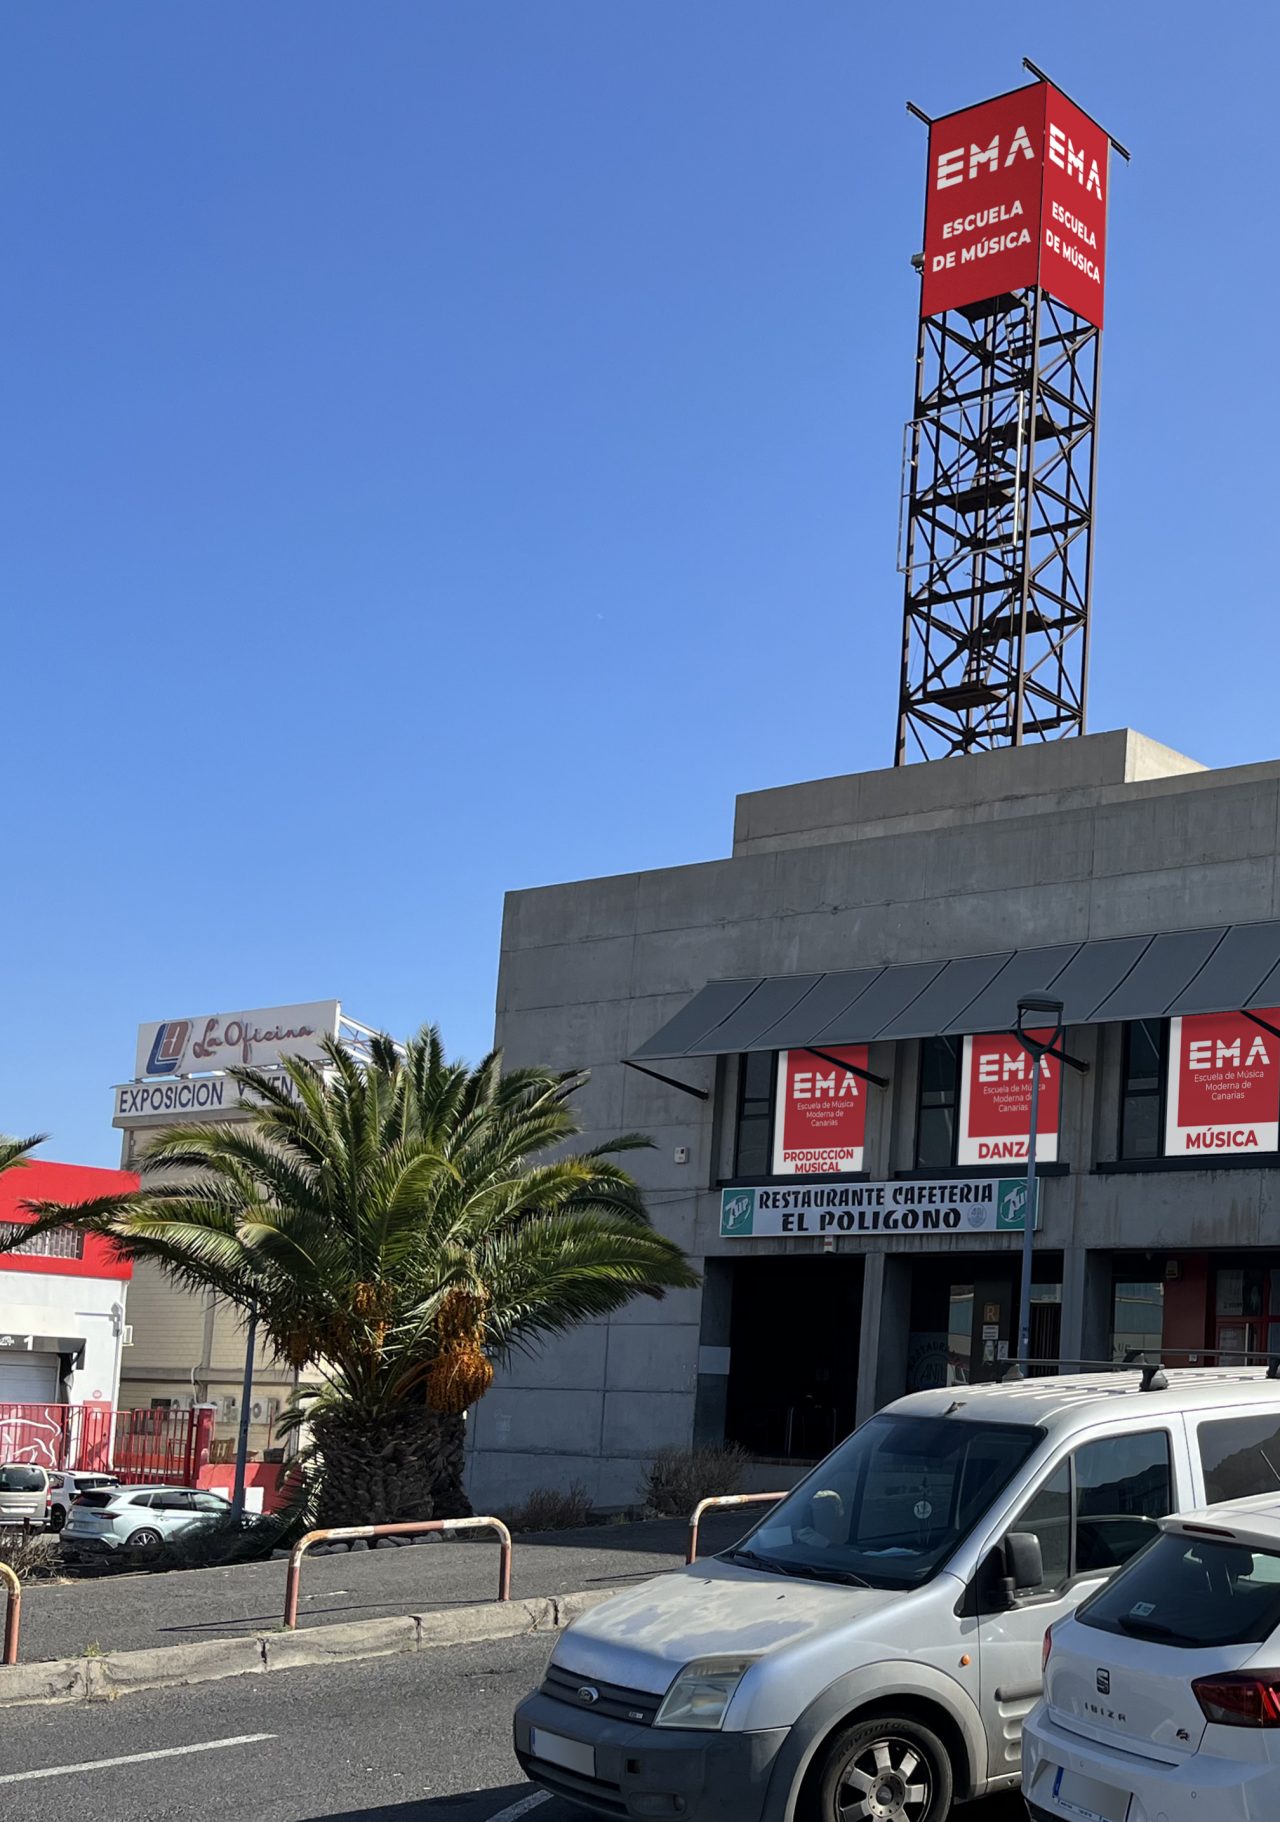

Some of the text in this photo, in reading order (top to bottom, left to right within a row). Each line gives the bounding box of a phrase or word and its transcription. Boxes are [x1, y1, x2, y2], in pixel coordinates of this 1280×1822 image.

[936, 125, 1035, 190] EMA
[1049, 122, 1103, 201] EMA
[942, 200, 1024, 240] ESCUELA
[1052, 200, 1097, 249] ESCUELA
[932, 228, 1032, 273] DE MÚSICA
[1045, 228, 1101, 284] DE MÚSICA
[193, 1018, 314, 1064] La Oficina
[1189, 1036, 1270, 1070] EMA
[793, 1071, 859, 1099] EMA
[1194, 1070, 1264, 1083] Escuela de Música
[1205, 1080, 1252, 1091] Moderna de
[119, 1081, 224, 1113] EXPOSICION
[983, 1084, 1009, 1094] Escuela
[1010, 1083, 1020, 1092] de
[993, 1094, 1024, 1103] Moderna
[1211, 1091, 1245, 1101] Canarias
[797, 1101, 821, 1110] Escuela
[832, 1099, 854, 1108] Música
[806, 1109, 844, 1118] Moderna de
[998, 1104, 1028, 1113] Canarias
[811, 1119, 838, 1127] Canarias
[1185, 1127, 1259, 1149] MÚSICA
[795, 1162, 841, 1173] MUSICAL
[759, 1183, 993, 1209] RESTAURANTE CAFETERIA
[781, 1213, 809, 1232] EL
[819, 1208, 962, 1231] POLIGONO
[1085, 1702, 1127, 1722] IBIZA
